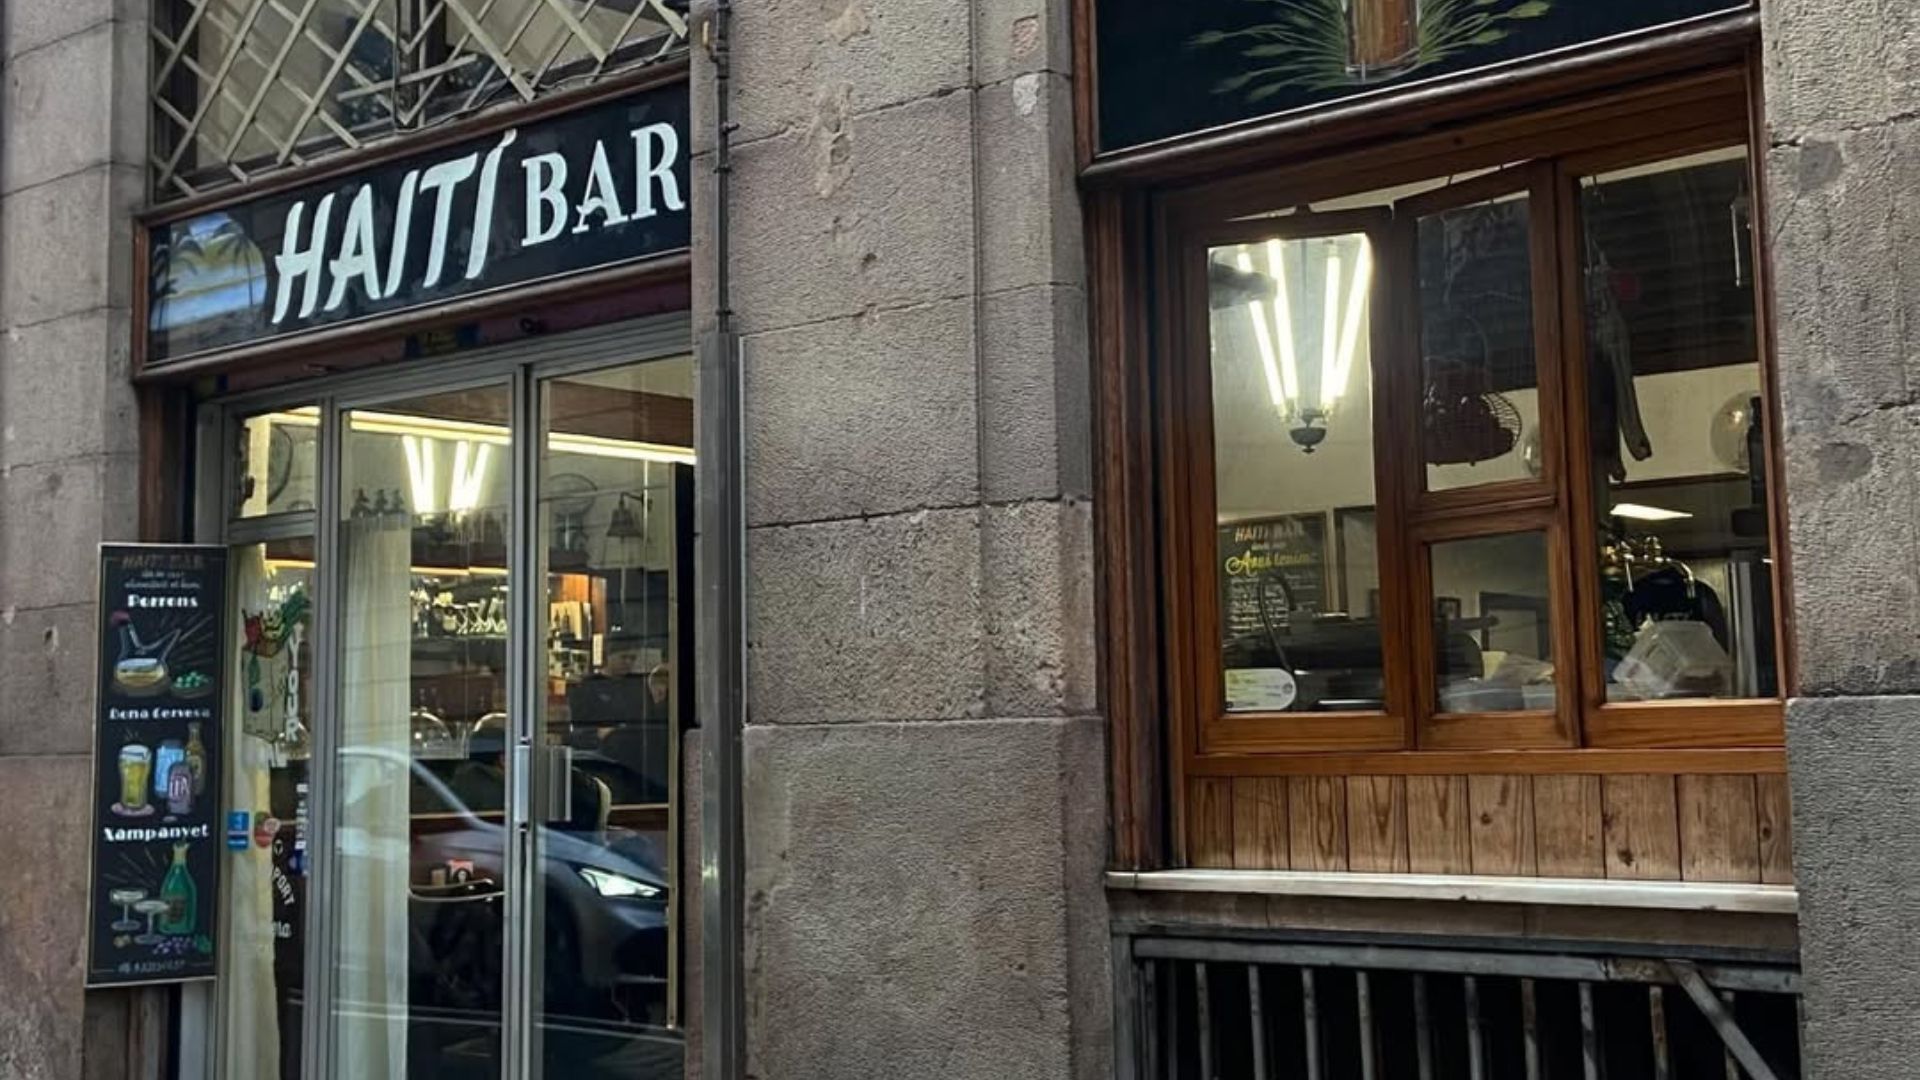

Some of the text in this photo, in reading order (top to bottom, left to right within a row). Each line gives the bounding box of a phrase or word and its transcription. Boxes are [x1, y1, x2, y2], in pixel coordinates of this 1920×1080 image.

[521, 122, 685, 247] BAR
[127, 593, 199, 608] Porrons
[109, 706, 211, 719] Bona Cervesa
[104, 823, 210, 842] Xampanyet
